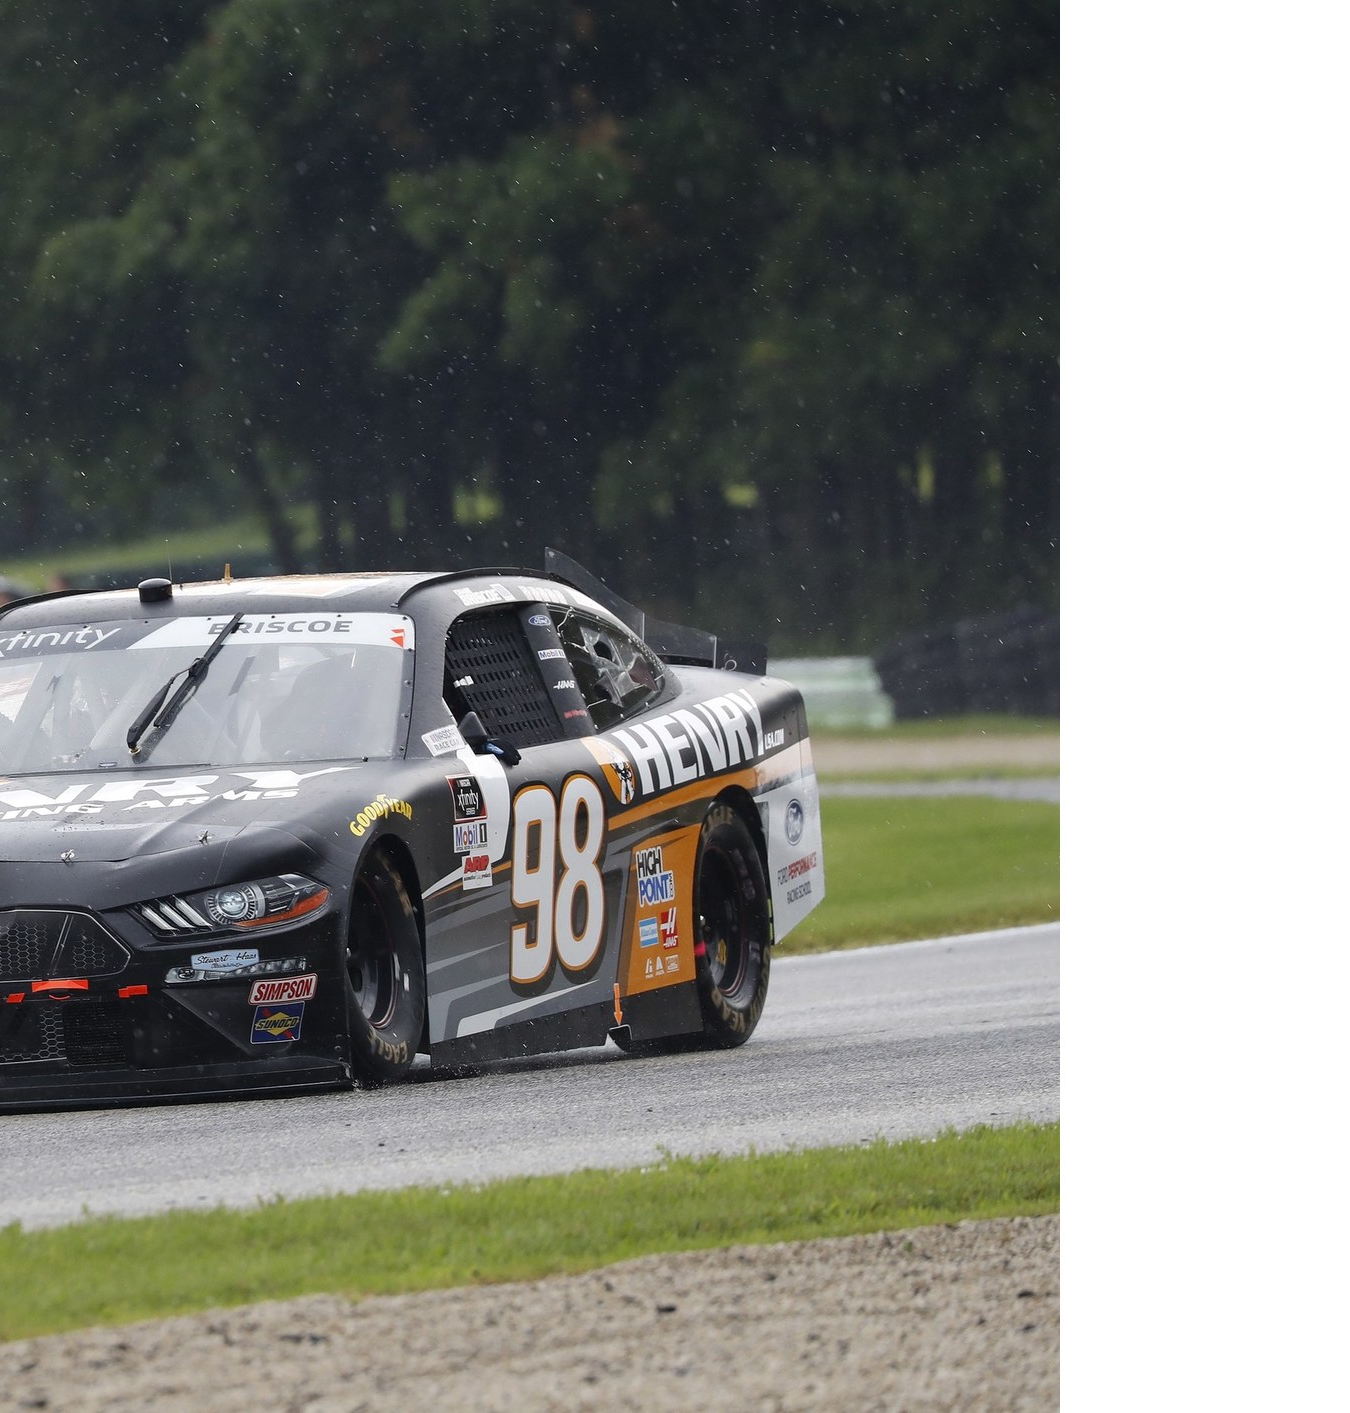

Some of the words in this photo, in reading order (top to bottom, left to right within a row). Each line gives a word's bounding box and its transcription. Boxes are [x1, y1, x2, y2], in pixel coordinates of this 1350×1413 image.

[207, 620, 353, 635] BRISCOE
[612, 689, 764, 796] HENRY
[121, 788, 301, 811] ARMS
[350, 794, 412, 837] GOODYEAR
[456, 825, 478, 846] Mobil
[480, 824, 487, 842] 1
[464, 855, 489, 874] ARP
[637, 850, 662, 878] HIGH
[511, 774, 605, 984] 98
[639, 873, 669, 905] POINT
[254, 978, 313, 1001] SIMPSON
[256, 1016, 299, 1030] SUNOCO
